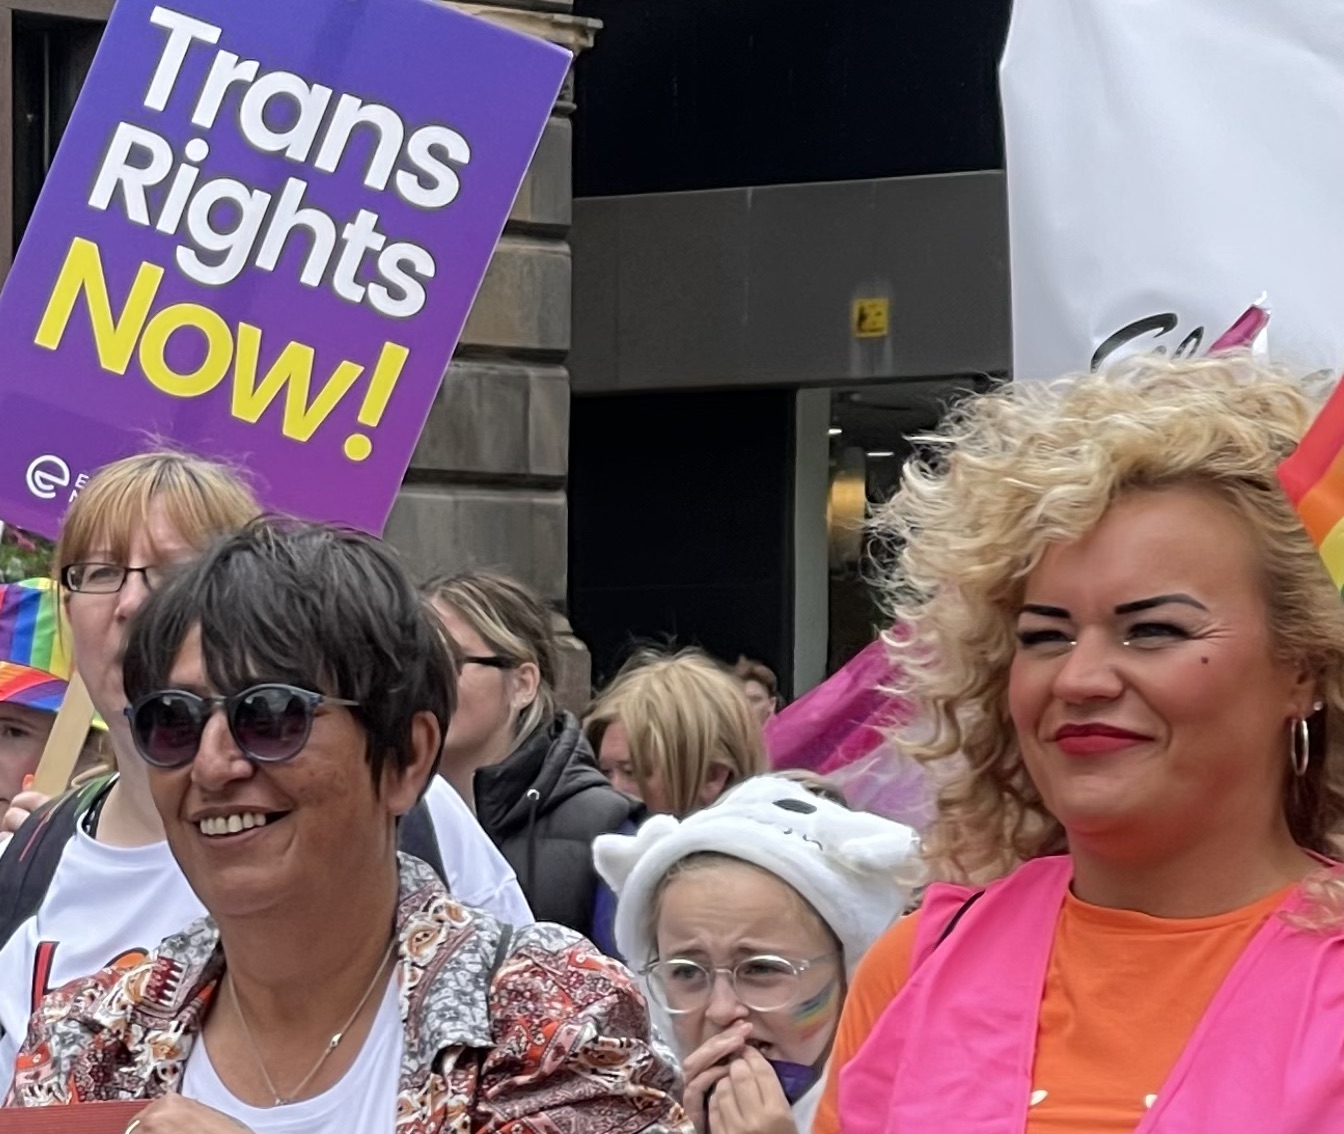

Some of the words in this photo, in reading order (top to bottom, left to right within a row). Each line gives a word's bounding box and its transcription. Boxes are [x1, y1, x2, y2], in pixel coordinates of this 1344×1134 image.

[143, 5, 471, 209] Trans
[87, 121, 436, 320] Rights
[34, 236, 410, 461] Now!
